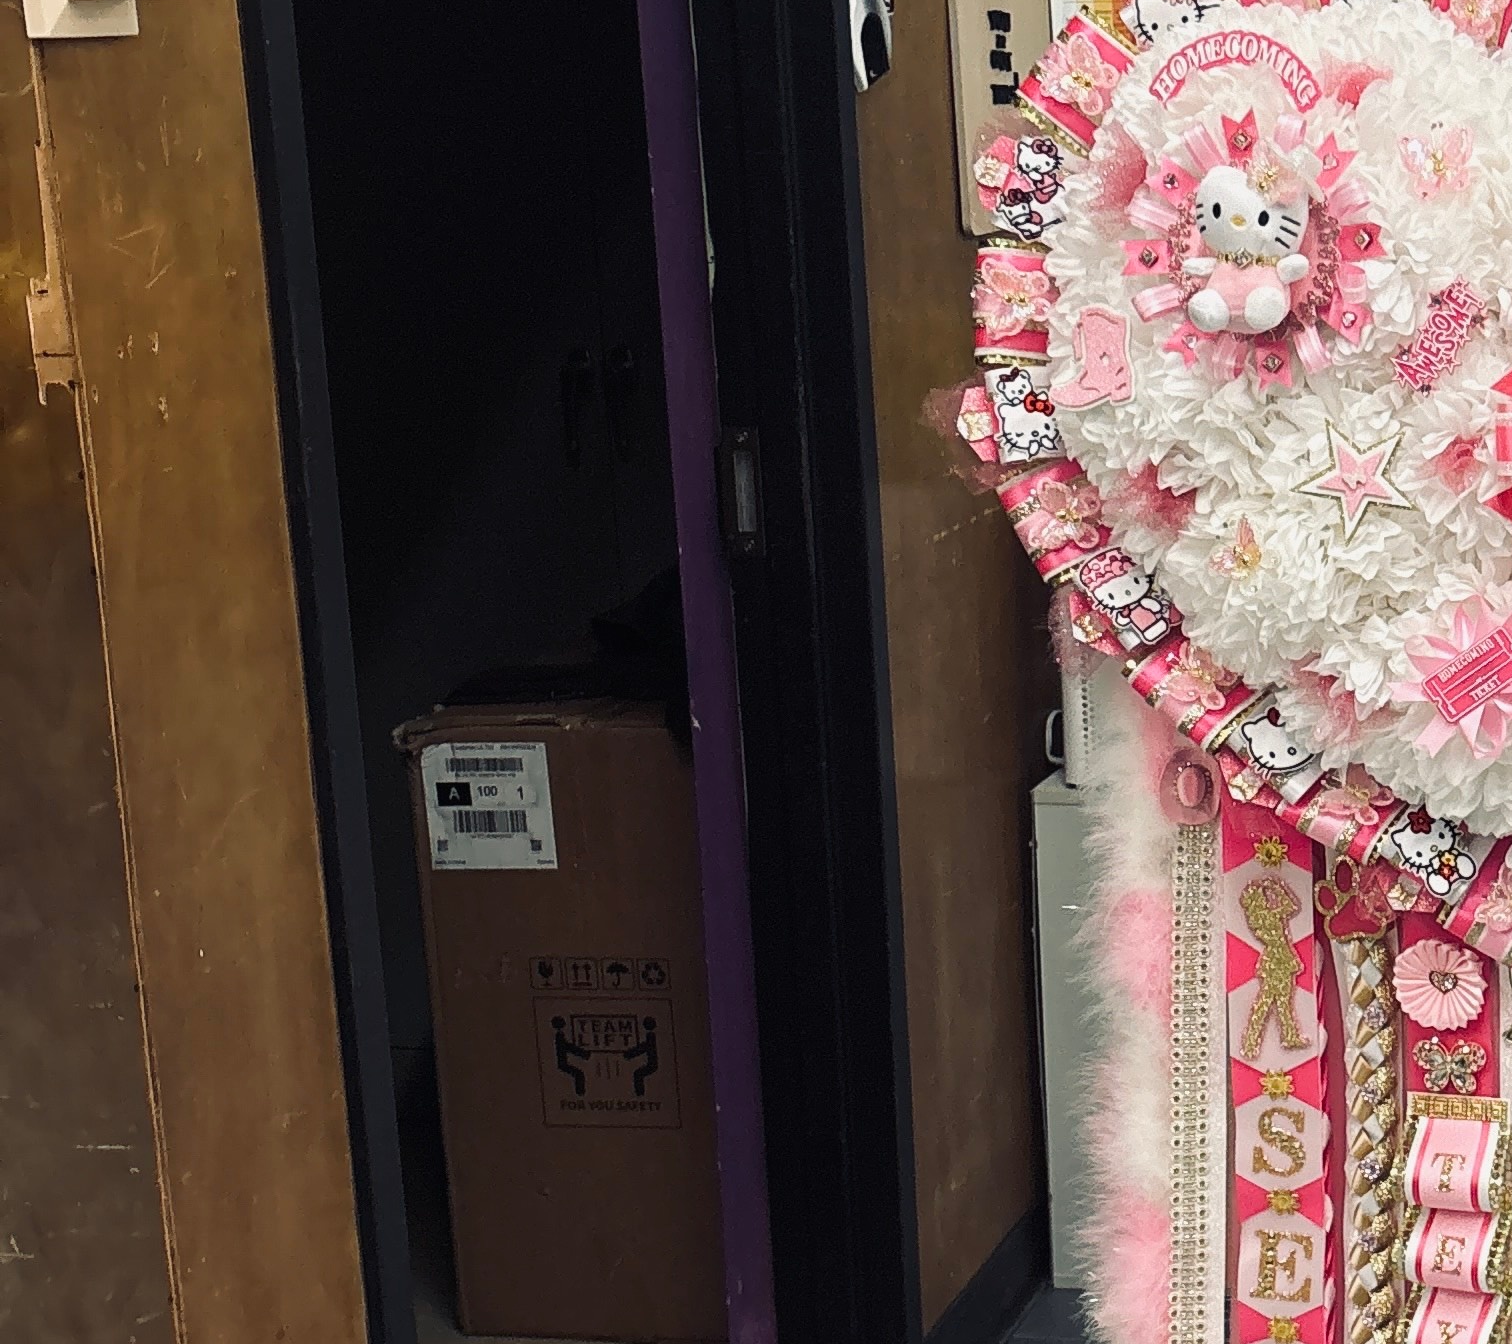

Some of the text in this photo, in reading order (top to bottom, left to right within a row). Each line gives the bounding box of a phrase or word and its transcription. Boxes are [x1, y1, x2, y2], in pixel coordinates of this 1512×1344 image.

[1153, 31, 1318, 107] HOMECOMING
[1391, 287, 1485, 390] AWESOME!
[1469, 674, 1501, 701] TICKET
[449, 787, 460, 800] A
[477, 786, 498, 797] 100
[517, 786, 524, 800] 1
[577, 1020, 632, 1033] TEAM
[578, 1034, 632, 1046] LIFT
[560, 1100, 586, 1111] FOR
[615, 1100, 662, 1111] SAFETY
